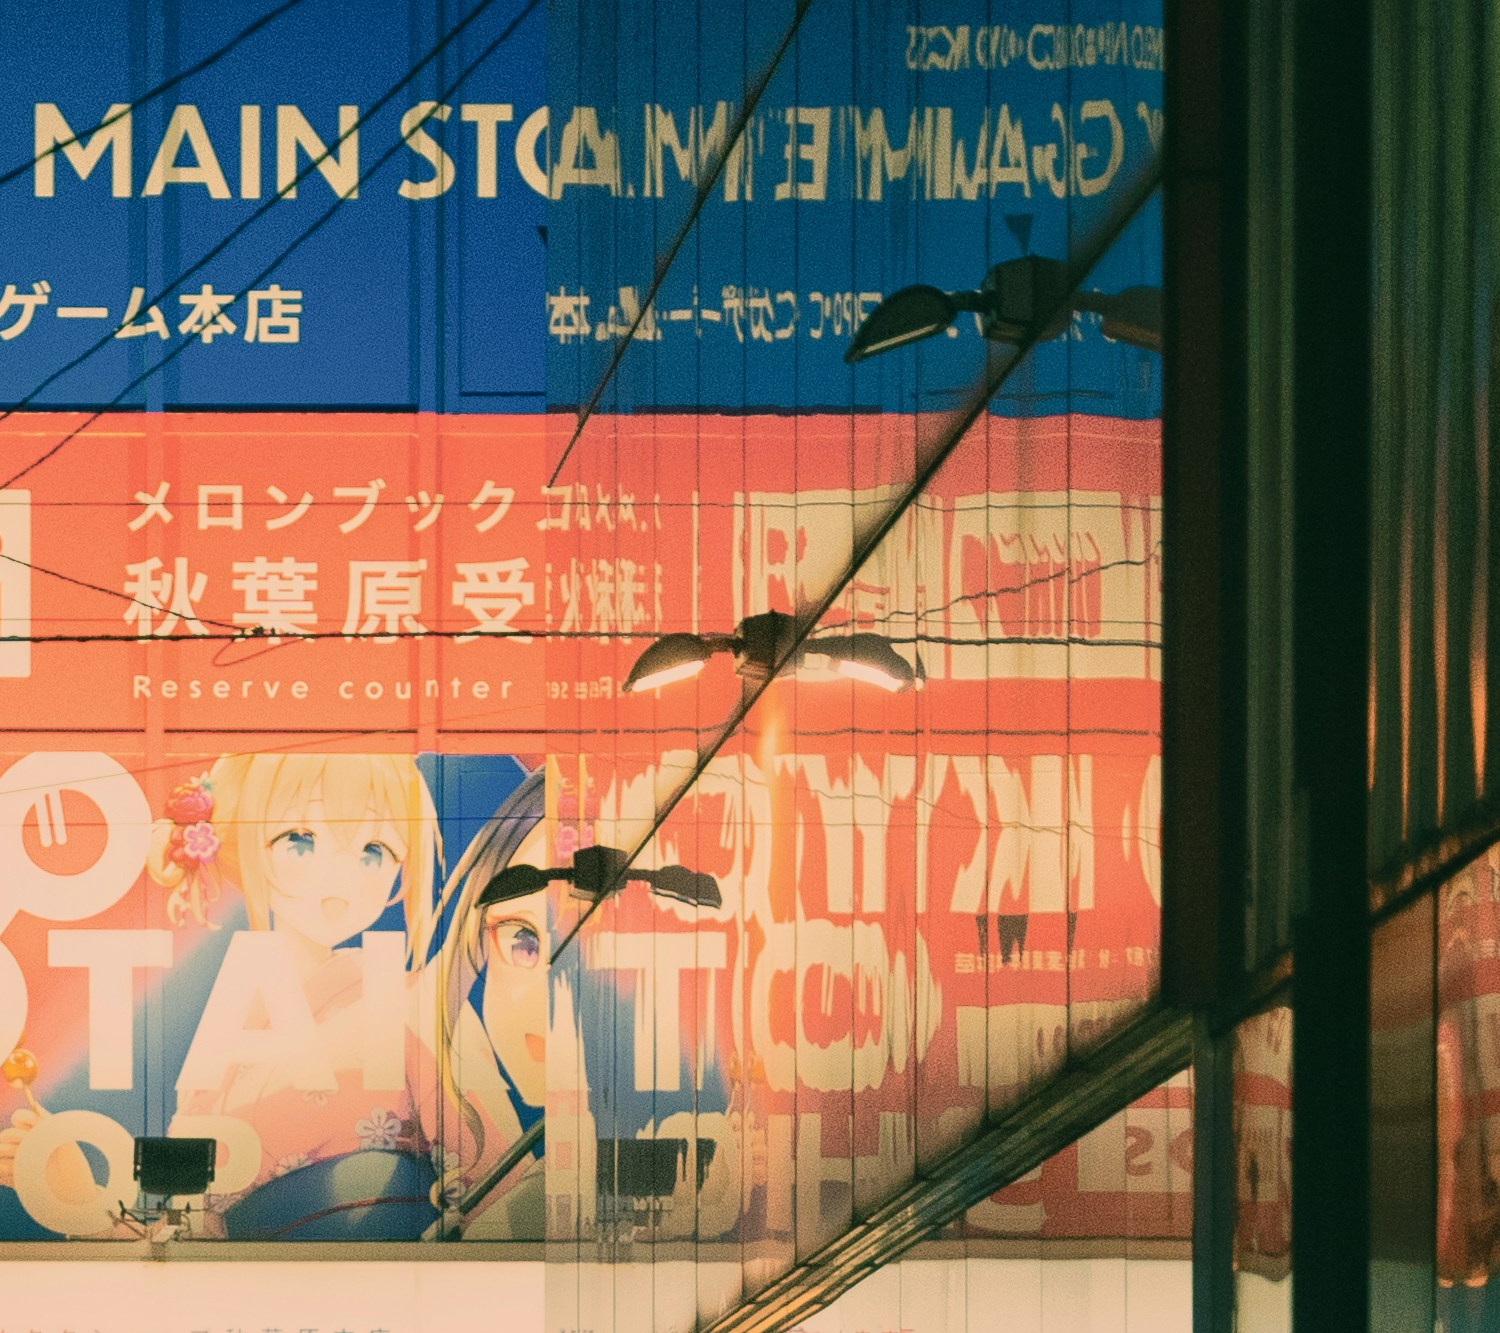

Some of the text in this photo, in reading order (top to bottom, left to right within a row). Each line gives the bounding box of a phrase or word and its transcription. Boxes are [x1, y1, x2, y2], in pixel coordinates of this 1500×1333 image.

[34, 101, 359, 200] MAIN
[133, 674, 514, 700] Reserve counter
